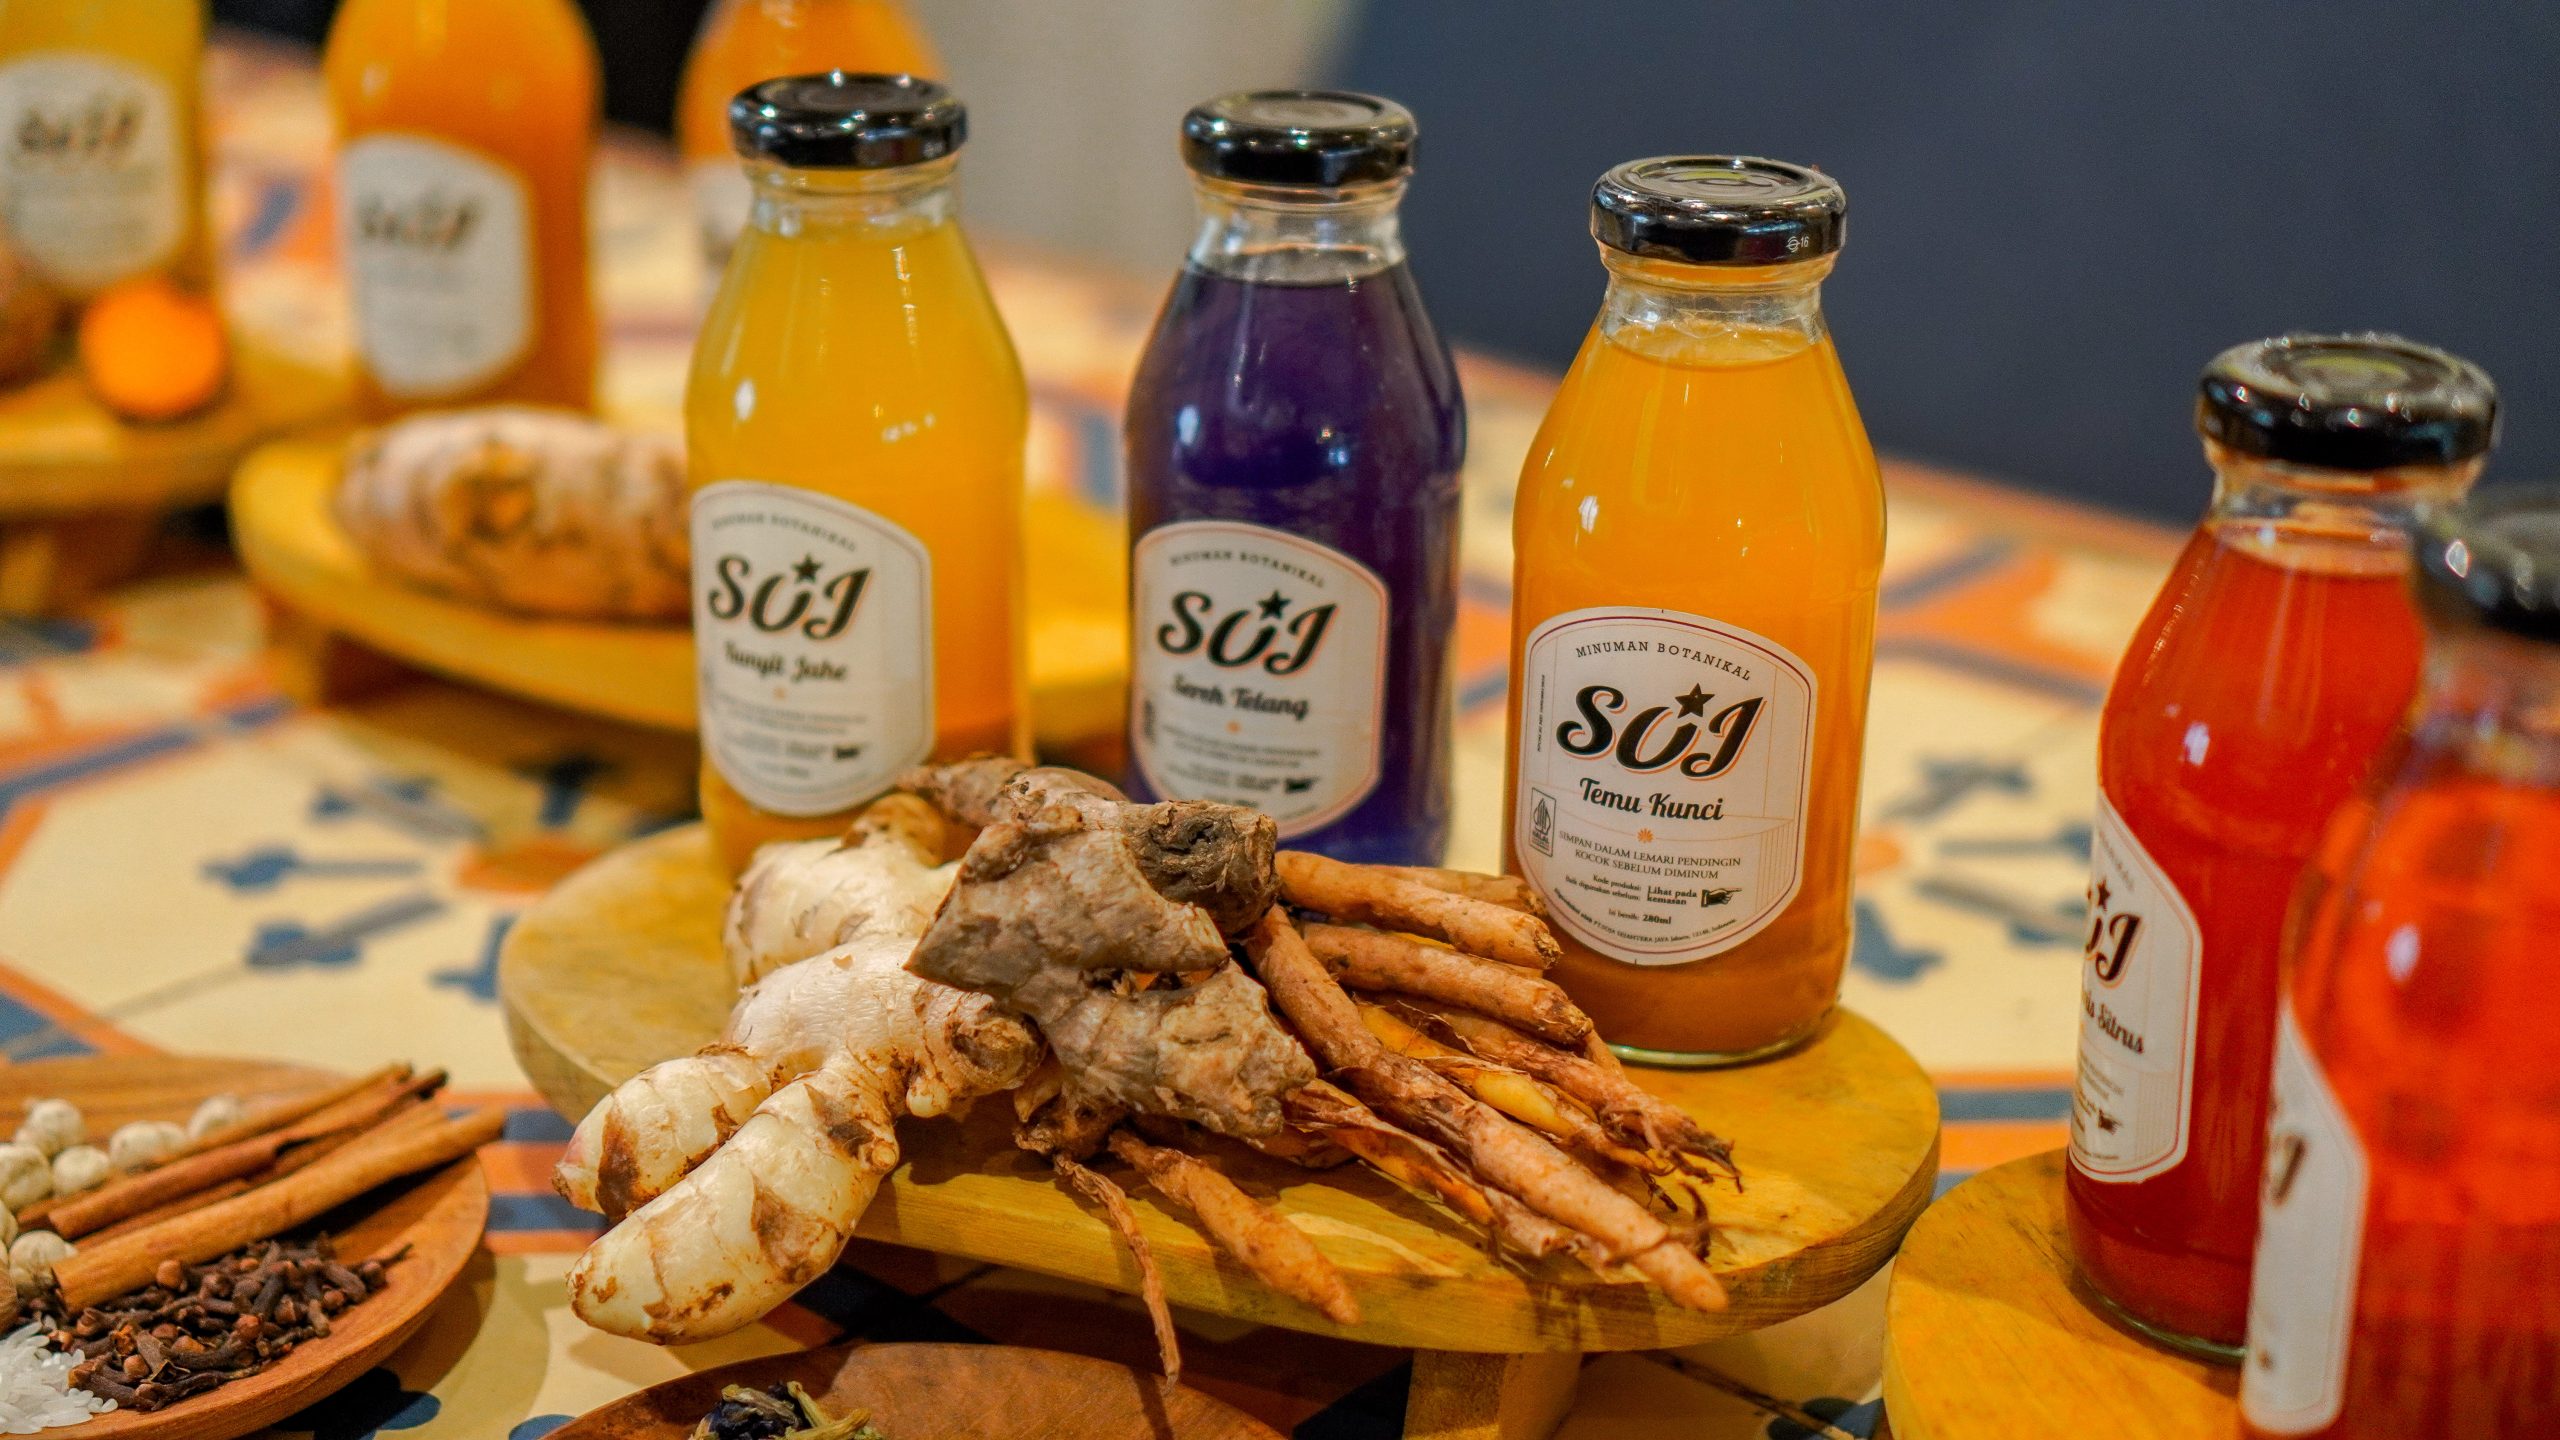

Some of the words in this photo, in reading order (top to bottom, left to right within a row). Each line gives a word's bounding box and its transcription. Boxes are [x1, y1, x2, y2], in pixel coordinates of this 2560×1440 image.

[1576, 641, 1649, 658] MINUMAN
[1657, 643, 1751, 681] BOTANIKAL
[1580, 777, 1642, 812] Temu
[1649, 792, 1724, 820] Kunci
[1559, 830, 1592, 849] SIMPAN
[1594, 840, 1630, 858] DALAM
[1633, 851, 1675, 865] LEMARI
[1677, 857, 1741, 867] PENDINGIN
[1575, 849, 1611, 866] KOCOK
[1612, 860, 1661, 876] SEBELUM
[1664, 868, 1719, 879] DIMINUM
[1647, 885, 1672, 896] Lihat
[1675, 889, 1697, 899] pada
[1647, 892, 1687, 905] kemasan
[1642, 914, 1672, 925] 280ml
